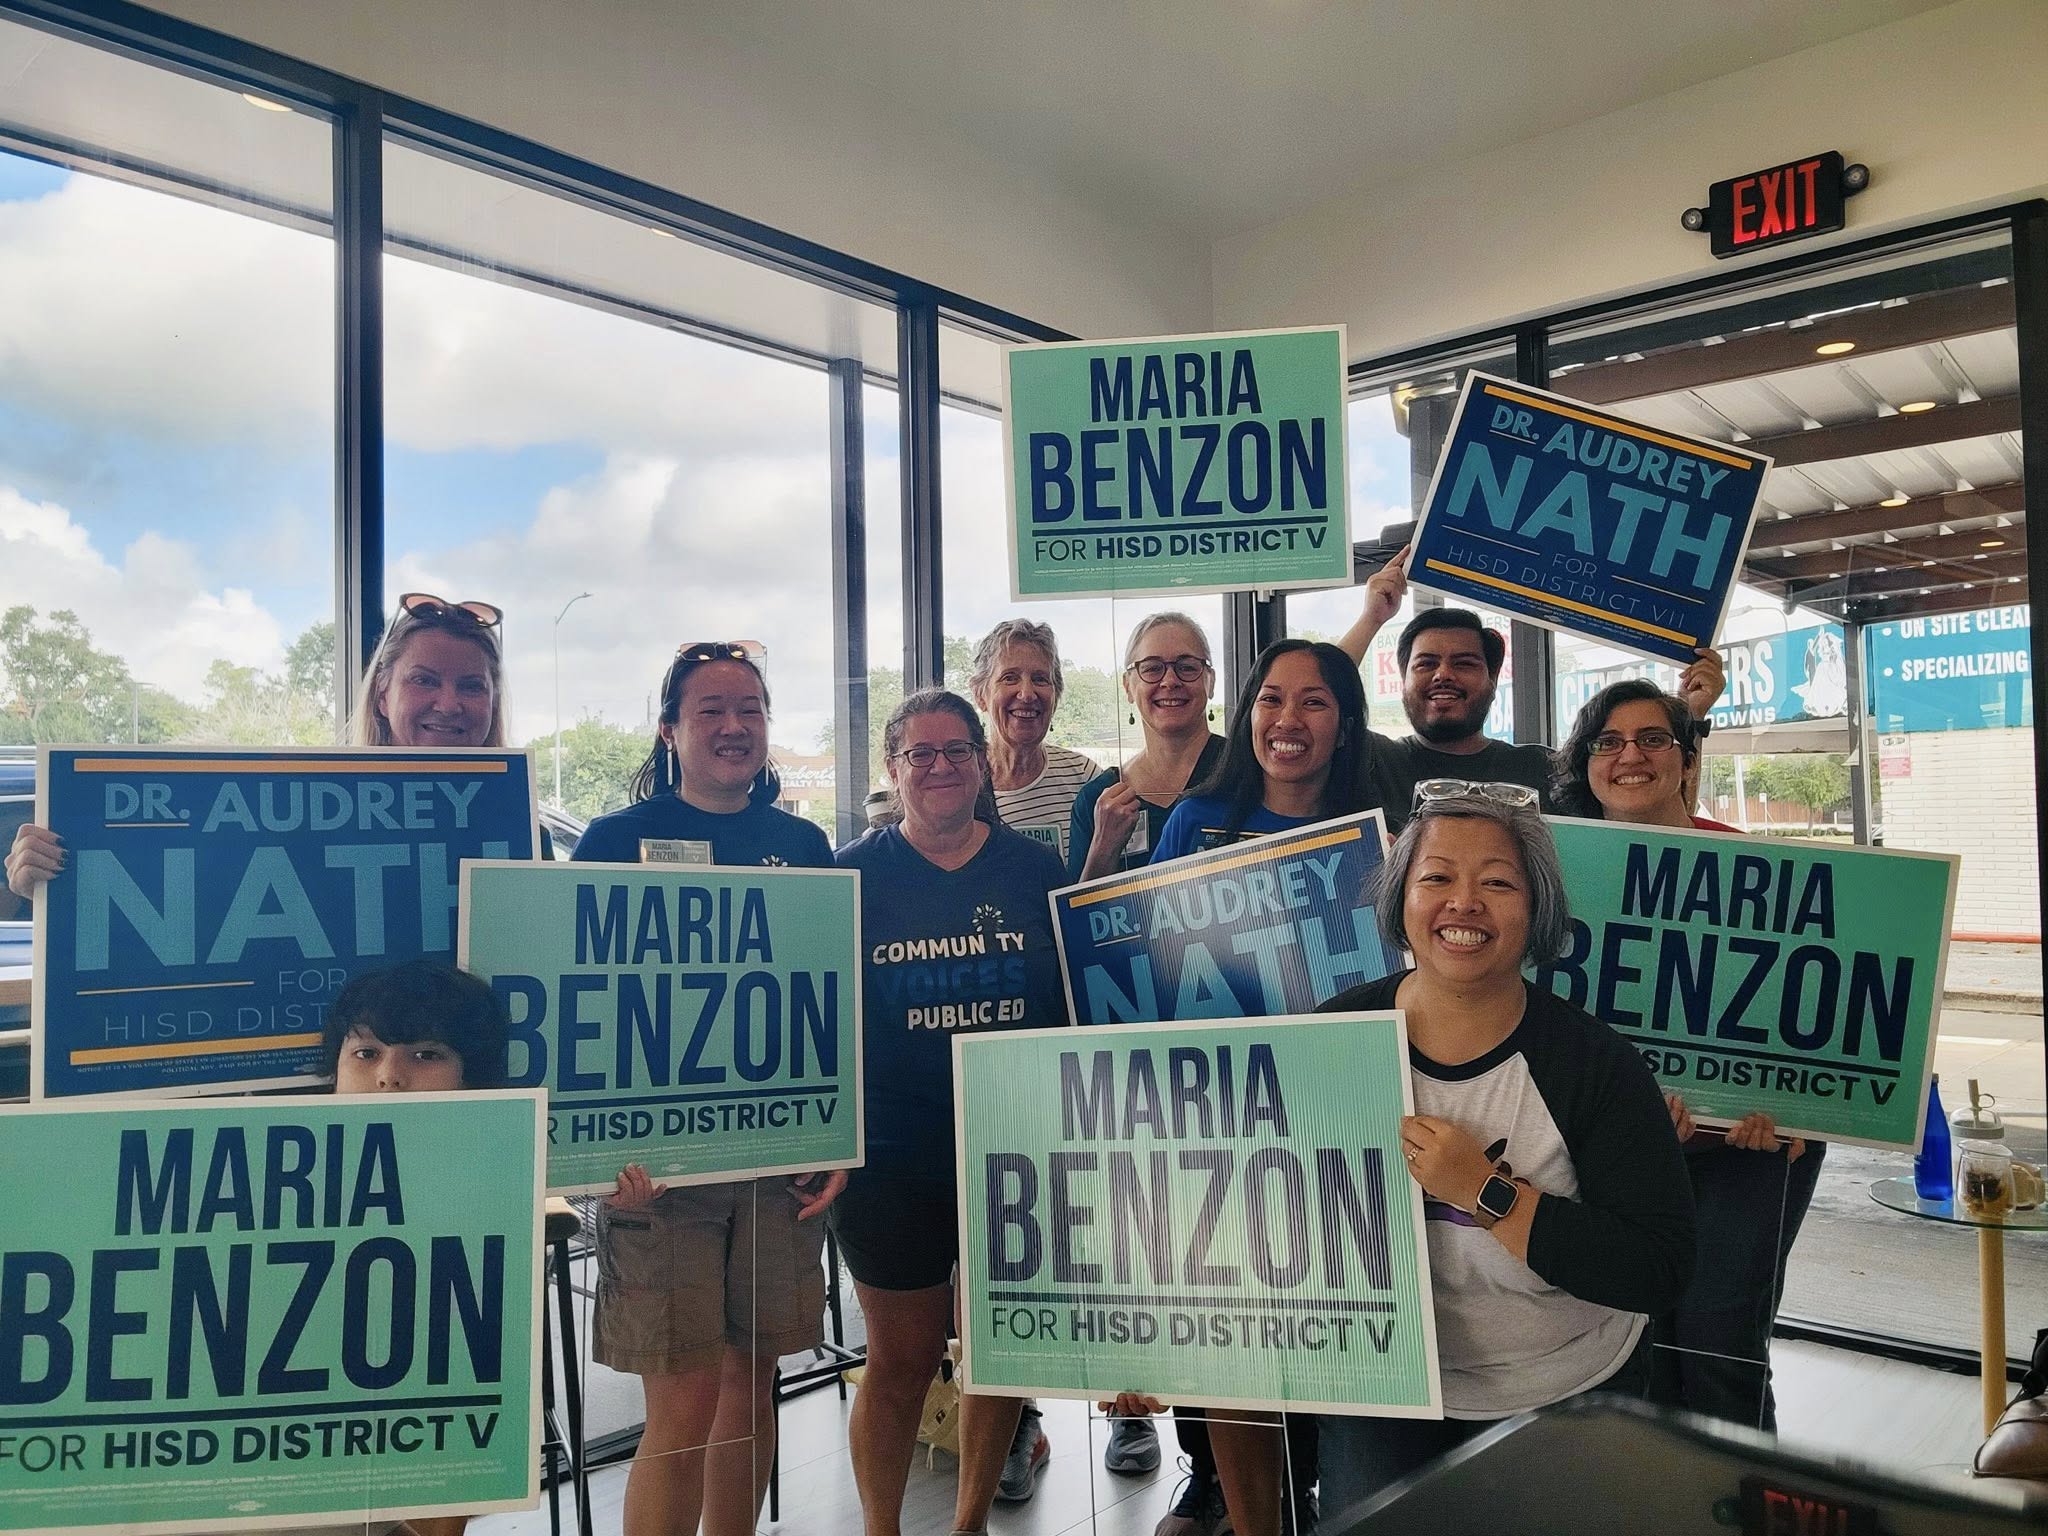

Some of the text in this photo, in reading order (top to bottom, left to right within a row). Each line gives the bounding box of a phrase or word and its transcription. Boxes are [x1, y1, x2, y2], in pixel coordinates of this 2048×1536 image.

[1732, 160, 1821, 245] EXIT
[1090, 350, 1262, 422] MARIA
[1030, 418, 1328, 523] BENZON
[1491, 404, 1731, 500] DR. AUDREY
[1035, 526, 1327, 562] FOR HISD DISTRICT V
[1446, 441, 1732, 591] NATH
[1447, 545, 1509, 576] HISD
[1521, 567, 1641, 615] DISTRICT
[1653, 604, 1686, 630] VII
[1552, 553, 1598, 579] FOR
[1900, 619, 1925, 639] ON
[1931, 613, 1971, 637] SITE
[1901, 650, 2029, 682] SPECIALIZING
[104, 781, 483, 832] DR. AUDREY
[75, 841, 509, 971] NATH
[575, 884, 773, 965] MARIA
[1089, 852, 1344, 942] DR. AUDREY
[1621, 843, 1835, 939] MARIA
[279, 968, 348, 994] FOR
[1084, 905, 1387, 1025] NATH
[1536, 917, 1914, 1062] BENZON
[104, 1003, 327, 1042] HISD DIST
[491, 970, 838, 1092] BENZON
[908, 998, 1025, 1031] PUBLIC ED
[571, 1111, 653, 1142] HISD
[663, 1100, 808, 1136] DISTRICT
[818, 1098, 838, 1124] V
[1060, 1043, 1289, 1141] MARIA
[1695, 1056, 1861, 1101] DISTRICT
[1870, 1079, 1897, 1105] V
[115, 1123, 404, 1235] MARIA
[986, 1147, 1393, 1290] BENZON
[0, 1235, 505, 1405] BENZON
[992, 1307, 1395, 1354] FOR HISD DISTRICT V
[104, 1428, 219, 1469] HISD
[232, 1414, 453, 1463] DISTRICT
[465, 1412, 500, 1448] V
